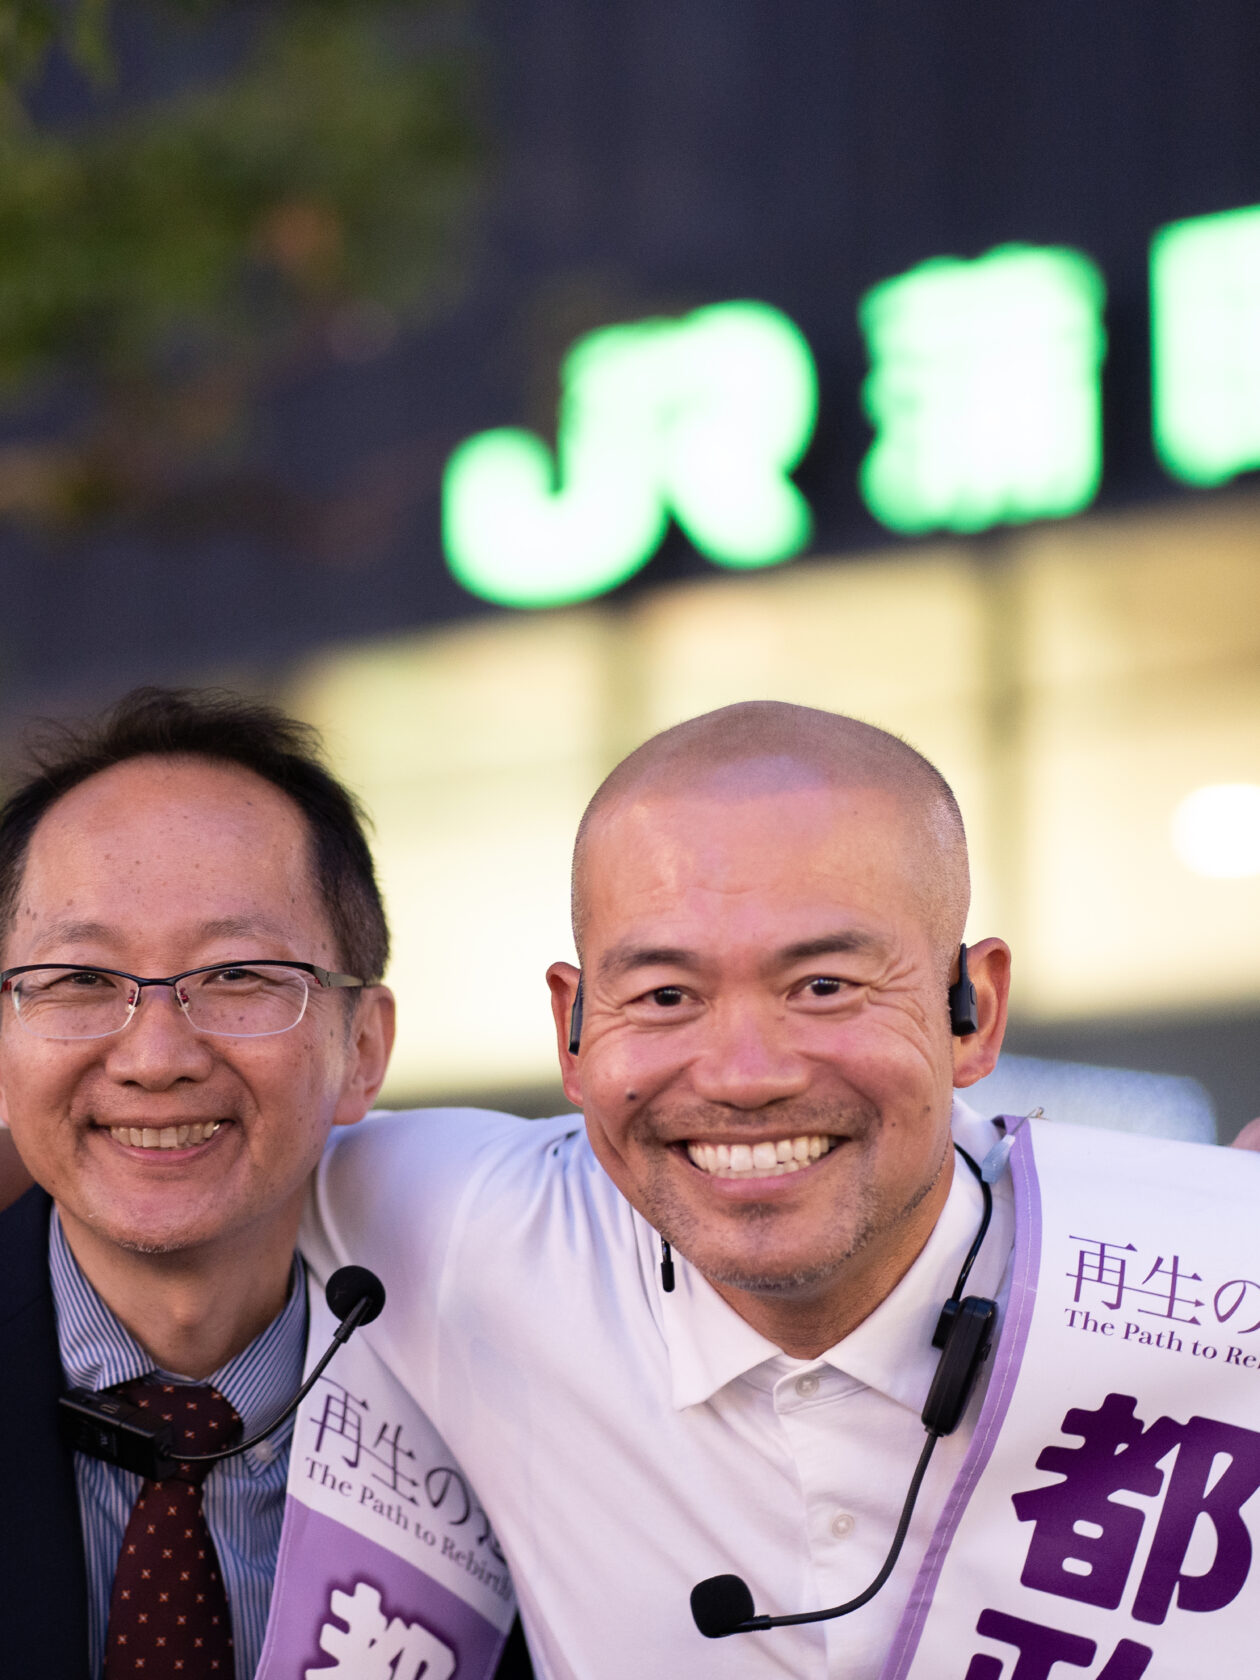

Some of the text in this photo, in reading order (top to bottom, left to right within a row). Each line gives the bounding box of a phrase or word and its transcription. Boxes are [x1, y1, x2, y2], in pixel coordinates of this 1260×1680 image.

[1066, 1234, 1260, 1334] 再生の
[1065, 1308, 1260, 1370] The Path to Re
[305, 1457, 352, 1497] The
[359, 1485, 409, 1530] Path
[414, 1519, 436, 1546] to
